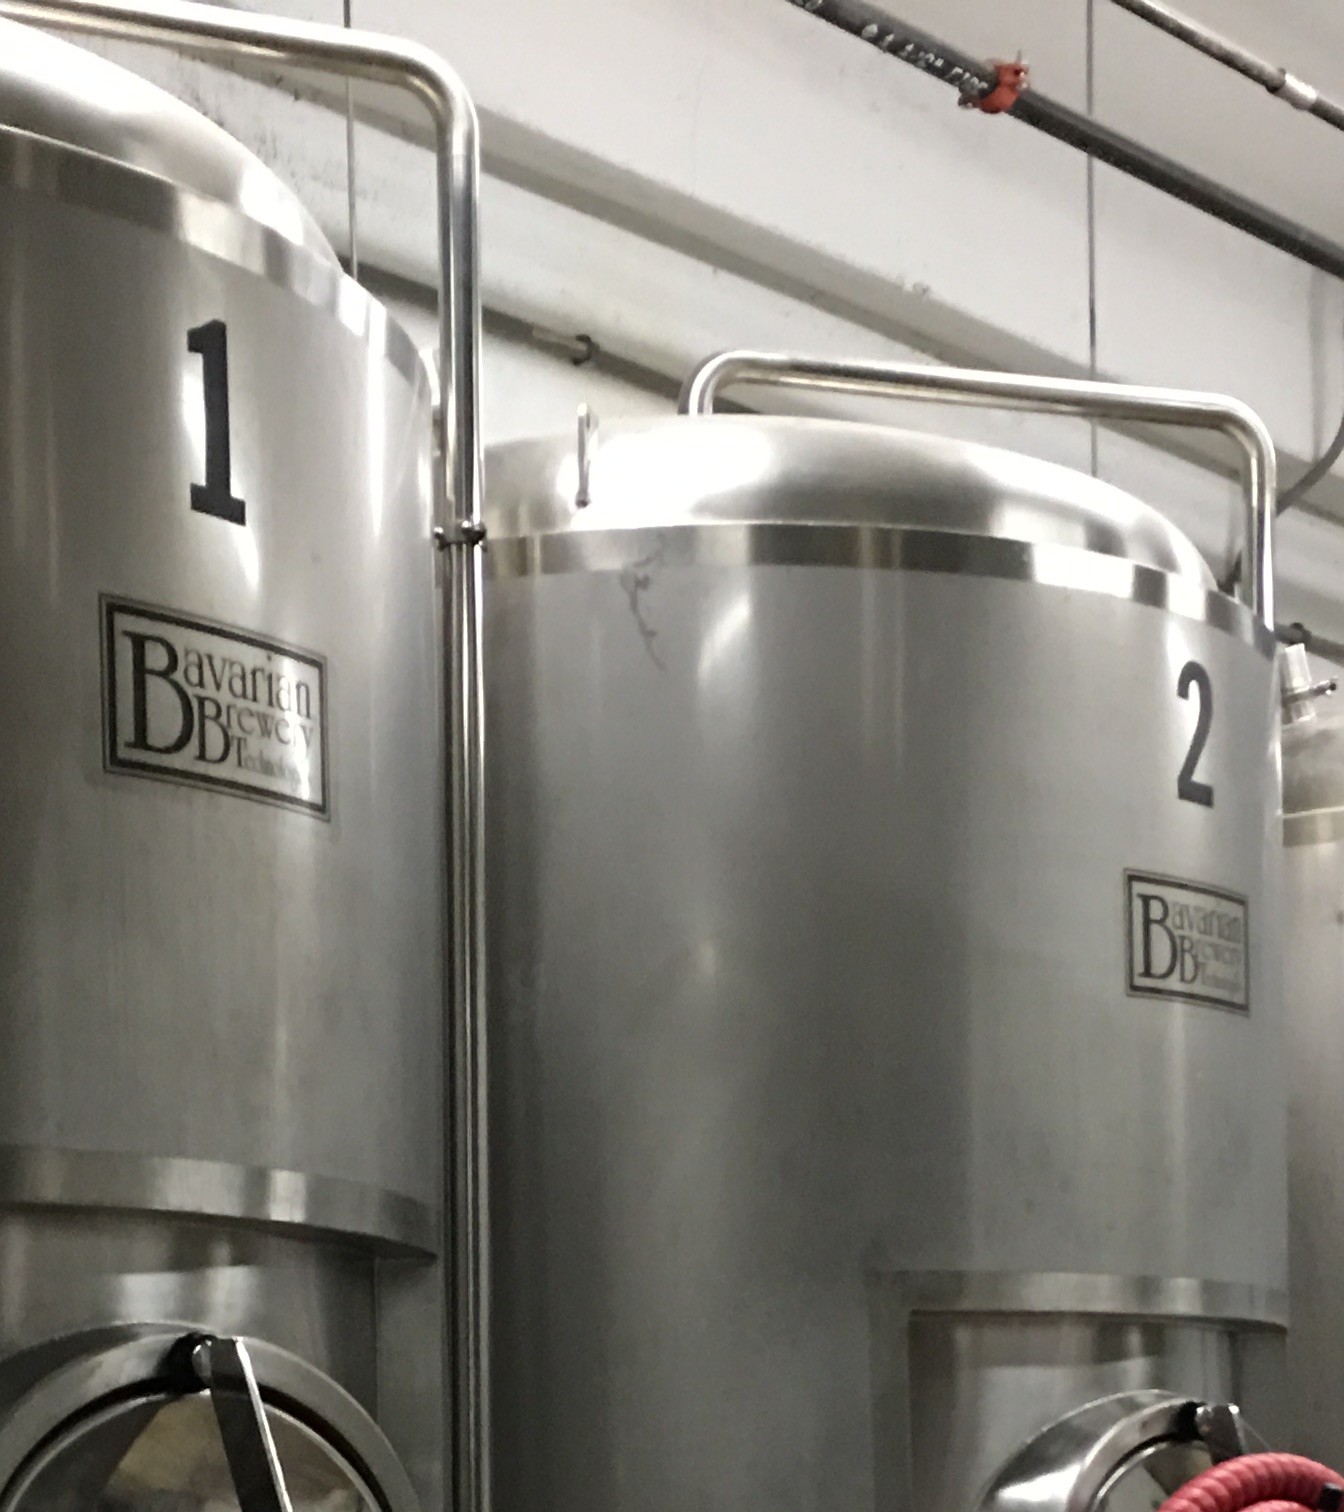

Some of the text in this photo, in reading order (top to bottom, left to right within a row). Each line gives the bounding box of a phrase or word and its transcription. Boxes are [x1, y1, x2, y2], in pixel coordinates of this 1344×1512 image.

[186, 318, 247, 527] 1
[121, 630, 312, 756] Bavarian
[192, 693, 315, 765] Brewery
[1176, 660, 1214, 808] 2
